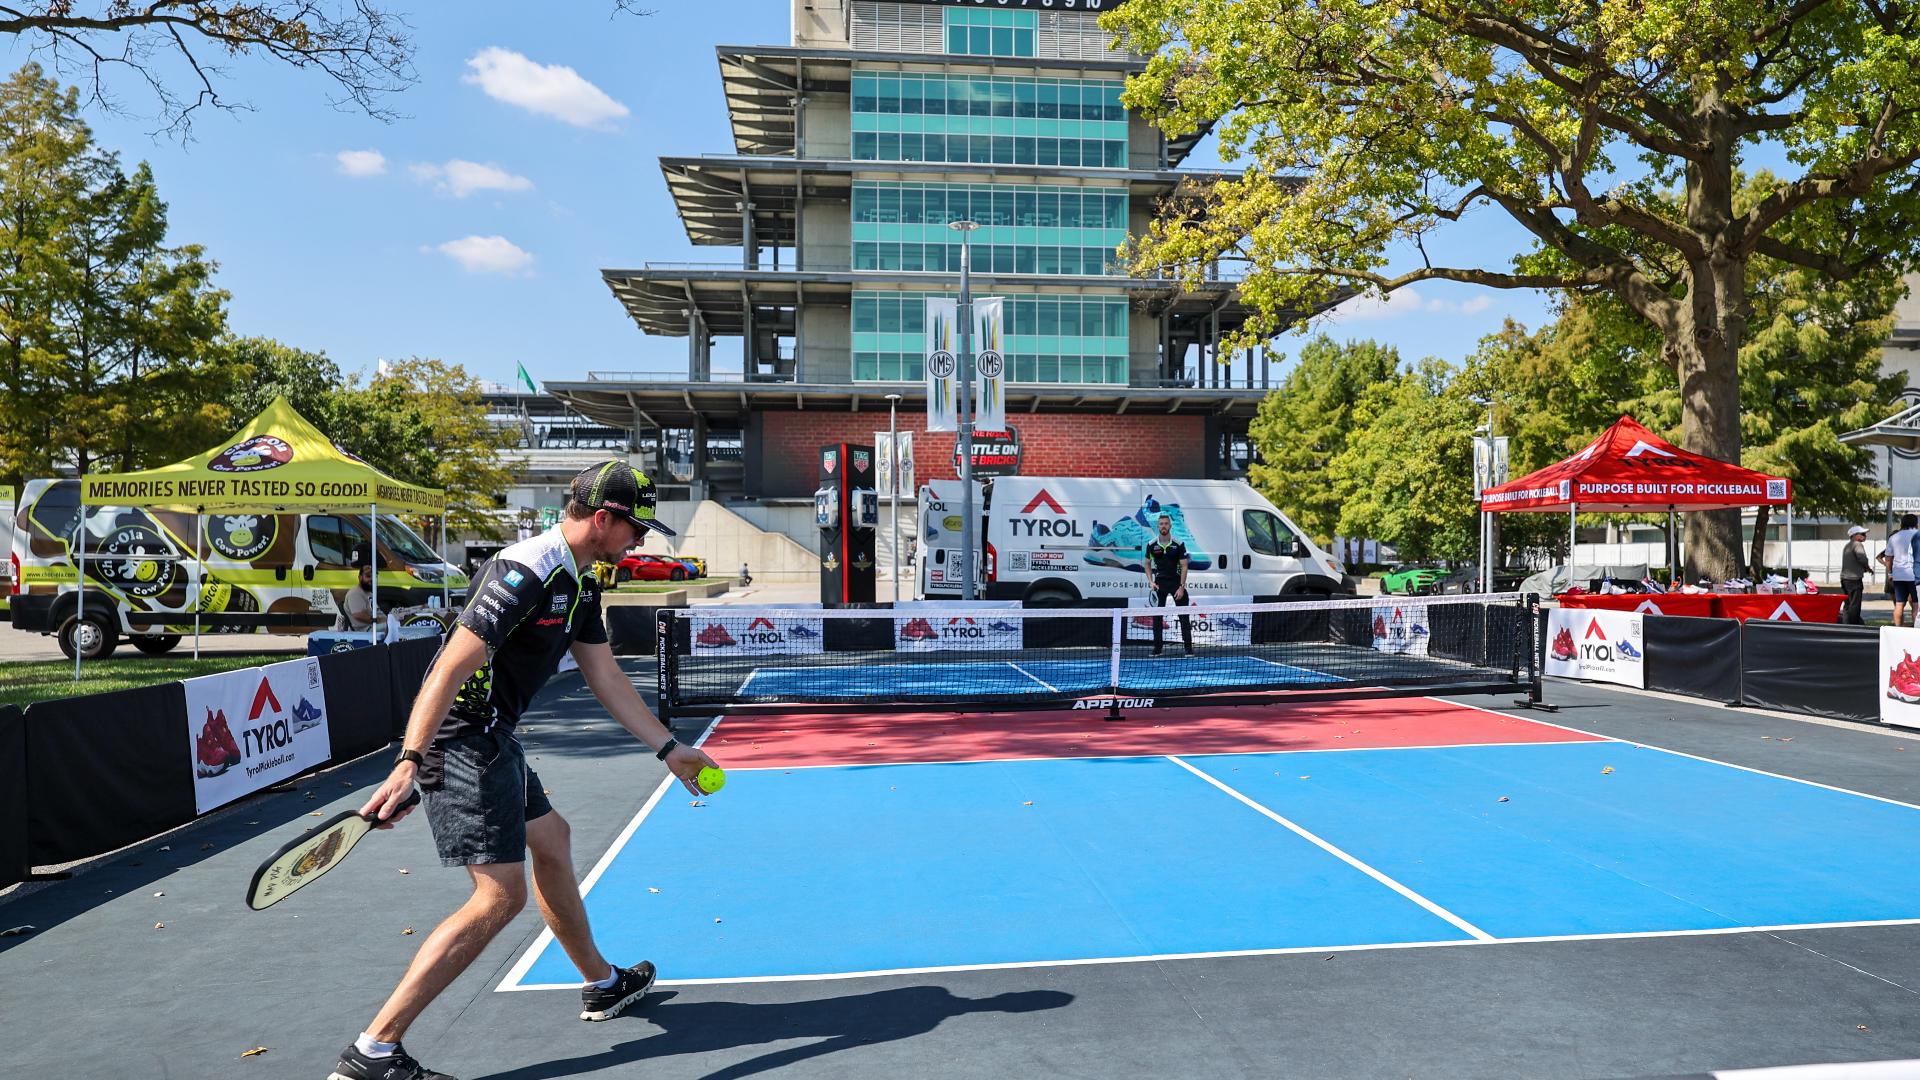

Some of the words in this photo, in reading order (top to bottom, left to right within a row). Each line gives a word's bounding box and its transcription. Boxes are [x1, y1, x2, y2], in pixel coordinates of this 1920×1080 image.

[1086, 0, 1101, 9] 10
[933, 355, 952, 374] IMS
[981, 355, 999, 374] IMS
[956, 444, 1000, 455] BTTLE
[1002, 444, 1019, 455] ON
[956, 456, 978, 465] TE
[979, 456, 1017, 465] BRICKS
[89, 481, 173, 498] MEMORIES
[178, 480, 226, 497] NEVER
[231, 479, 290, 497] TASTED
[295, 481, 316, 497] SO
[320, 482, 368, 497] GOOD!
[1518, 489, 1529, 500] FOR
[1579, 483, 1634, 494] PURPOSE
[1636, 483, 1667, 494] BUILT
[1670, 483, 1694, 494] FOR
[1696, 484, 1762, 495] PICKLEBALL
[1905, 499, 1920, 508] RAC
[1009, 519, 1084, 537] TYROL
[215, 537, 235, 555] Cow
[236, 535, 270, 557] Power!
[1090, 581, 1151, 589] PURPOSE-BUIL
[1184, 581, 1228, 589] ICKLEBALL
[481, 594, 506, 614] molex
[1173, 619, 1215, 632] TROL
[740, 632, 786, 645] TYROL
[942, 627, 985, 638] TYROL
[1072, 700, 1114, 710] APP
[1117, 698, 1155, 709] TOUR
[242, 718, 293, 758] TYROL
